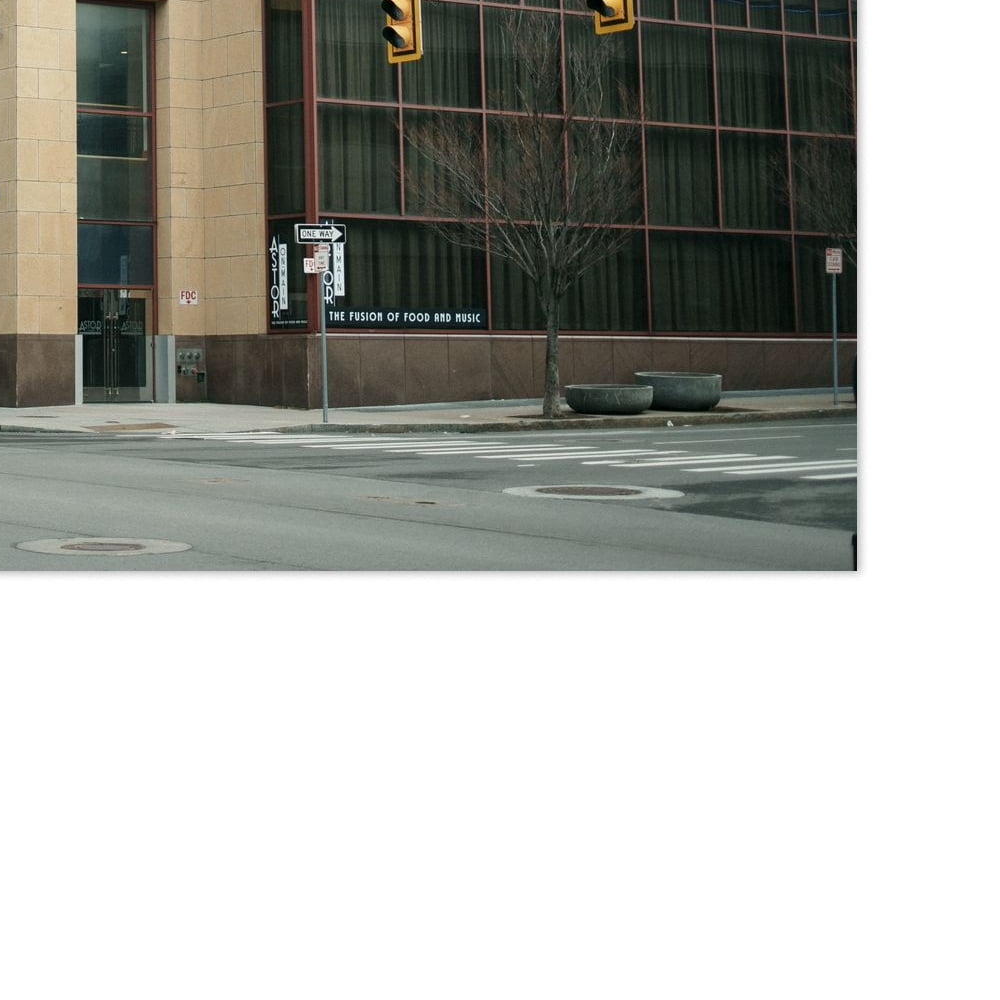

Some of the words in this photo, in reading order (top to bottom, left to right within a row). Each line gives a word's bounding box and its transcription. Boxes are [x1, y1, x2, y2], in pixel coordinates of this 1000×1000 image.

[269, 236, 280, 318] ASTOR
[180, 290, 197, 300] FDC
[329, 311, 345, 321] THE
[349, 311, 383, 321] FUSION
[387, 312, 400, 322] OF
[404, 312, 430, 322] FOOD
[434, 313, 451, 322] AND
[455, 313, 481, 323] MUSIC
